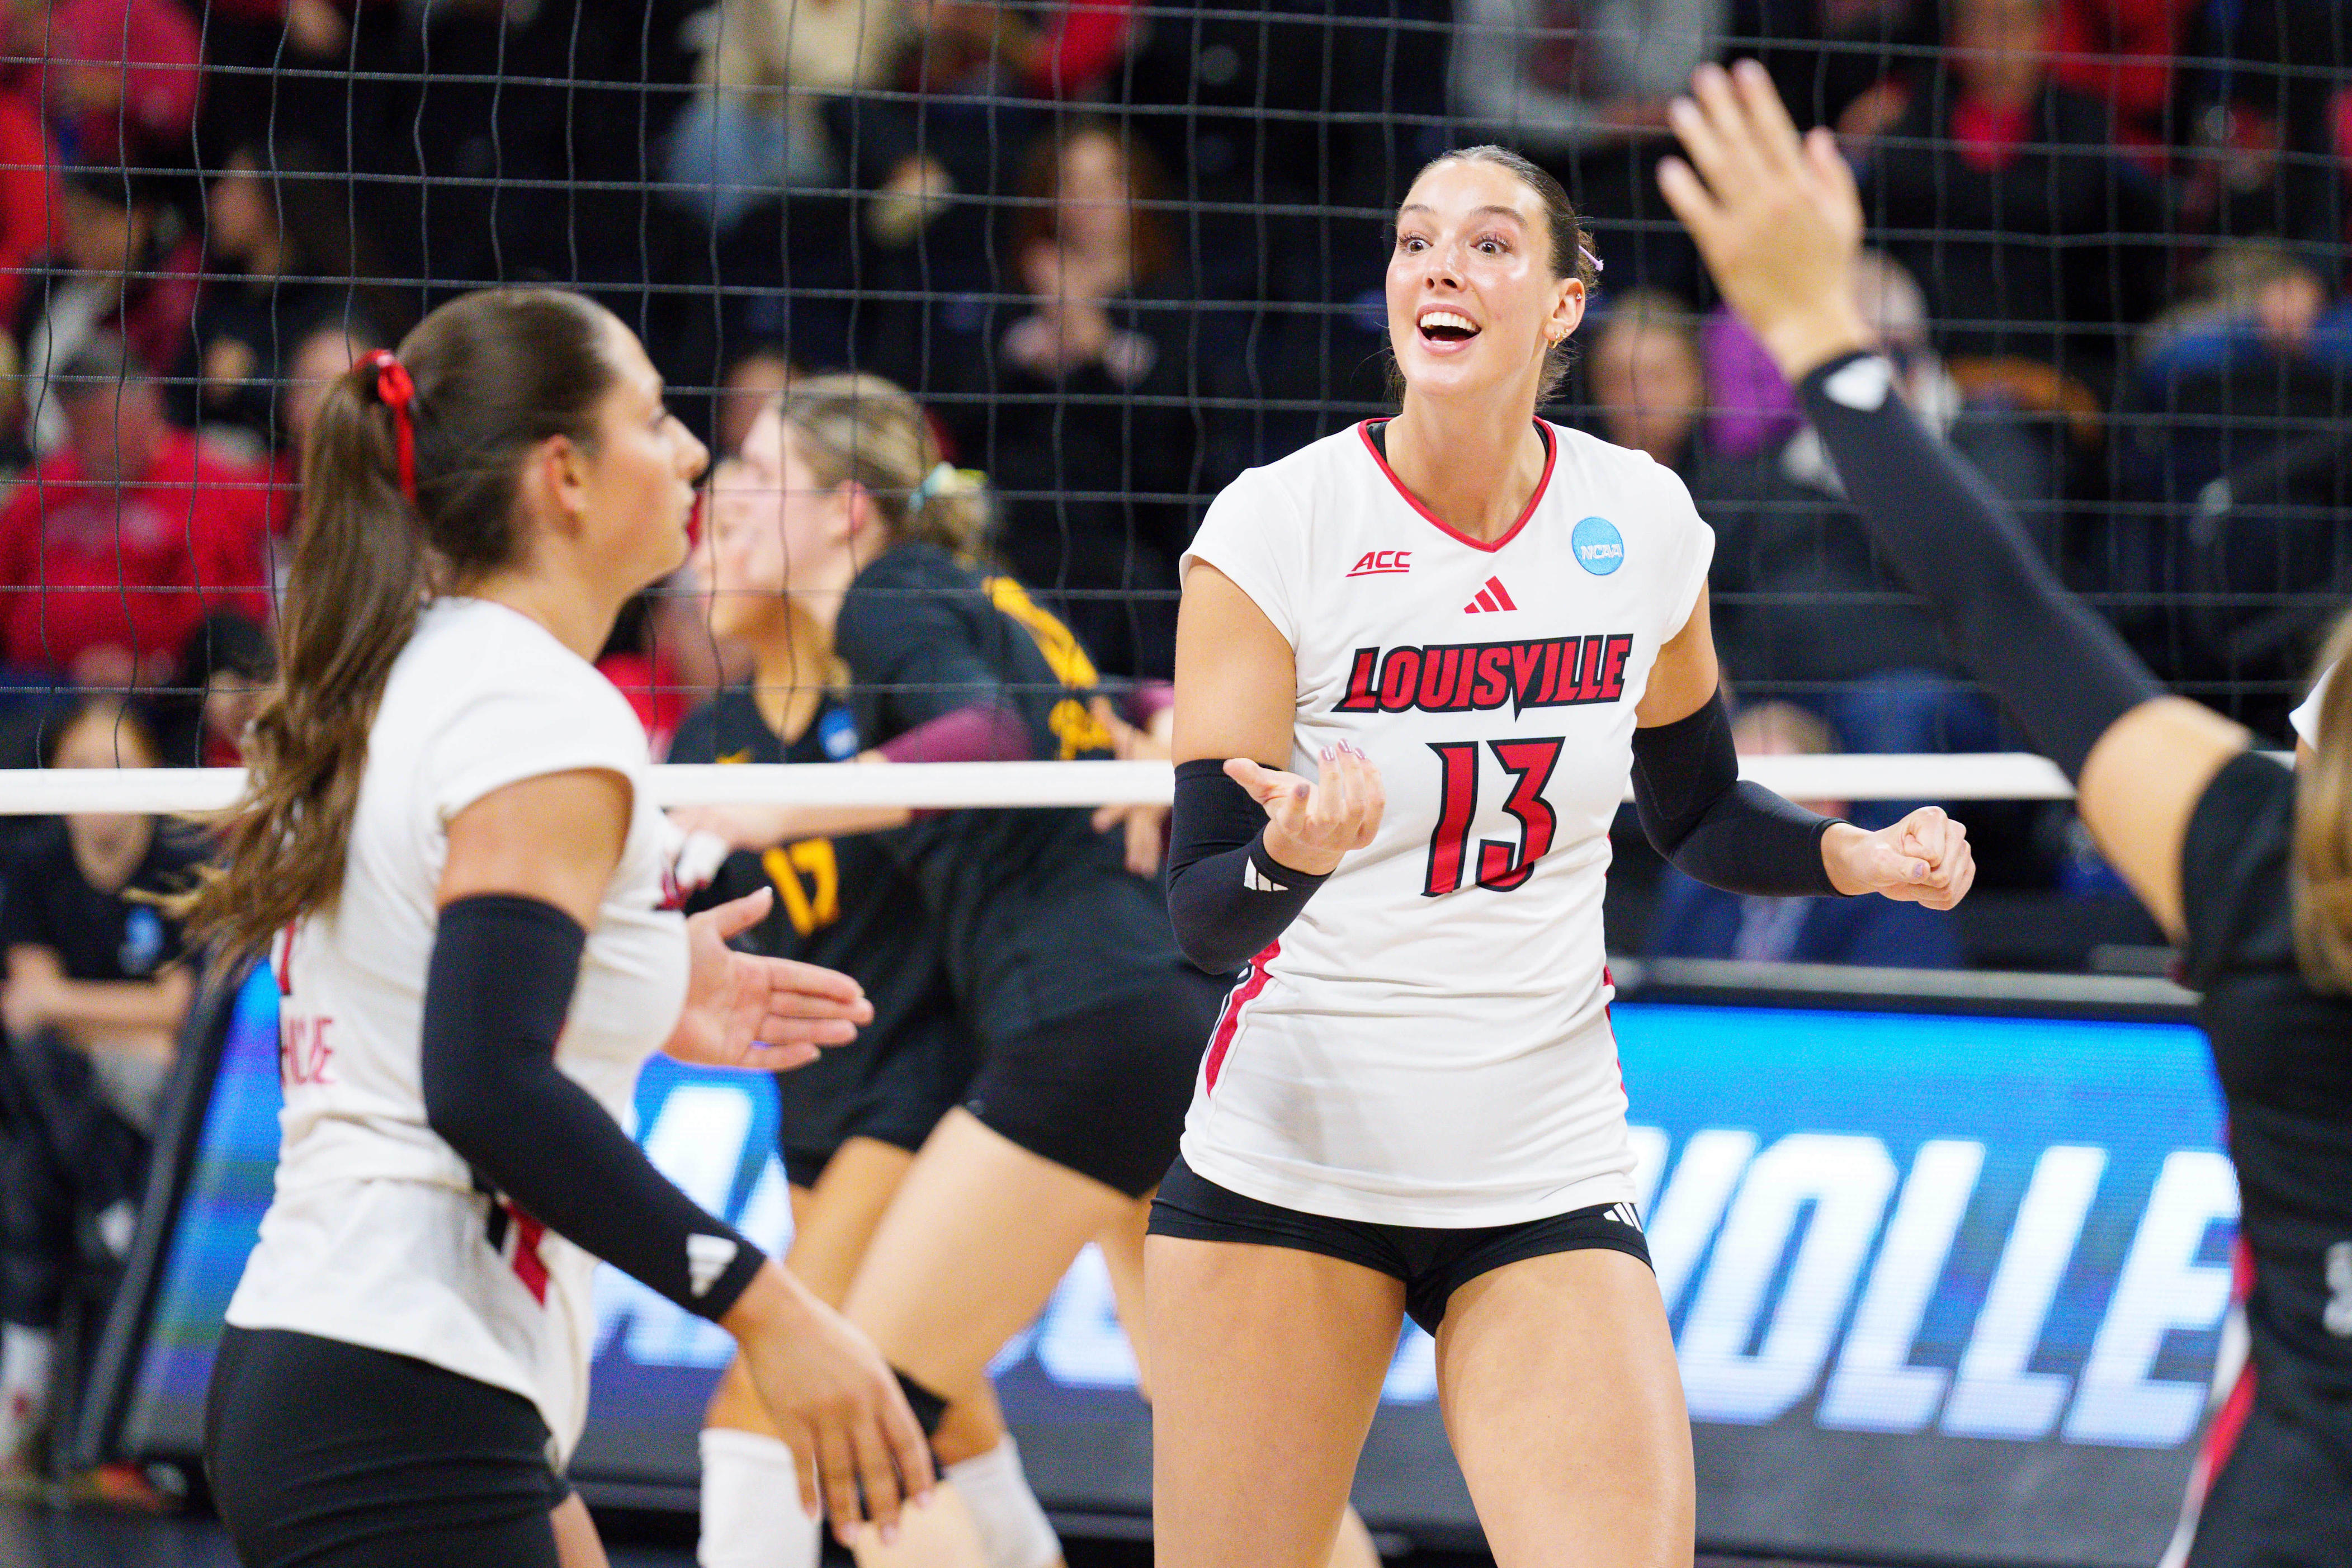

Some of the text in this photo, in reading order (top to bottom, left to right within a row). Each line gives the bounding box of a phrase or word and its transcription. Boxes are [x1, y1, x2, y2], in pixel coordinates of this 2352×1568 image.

[1351, 551, 1413, 572] ACC
[1580, 543, 1623, 559] NCAA
[1330, 633, 1633, 722] LOUISVILLE
[1421, 736, 1566, 897] 13
